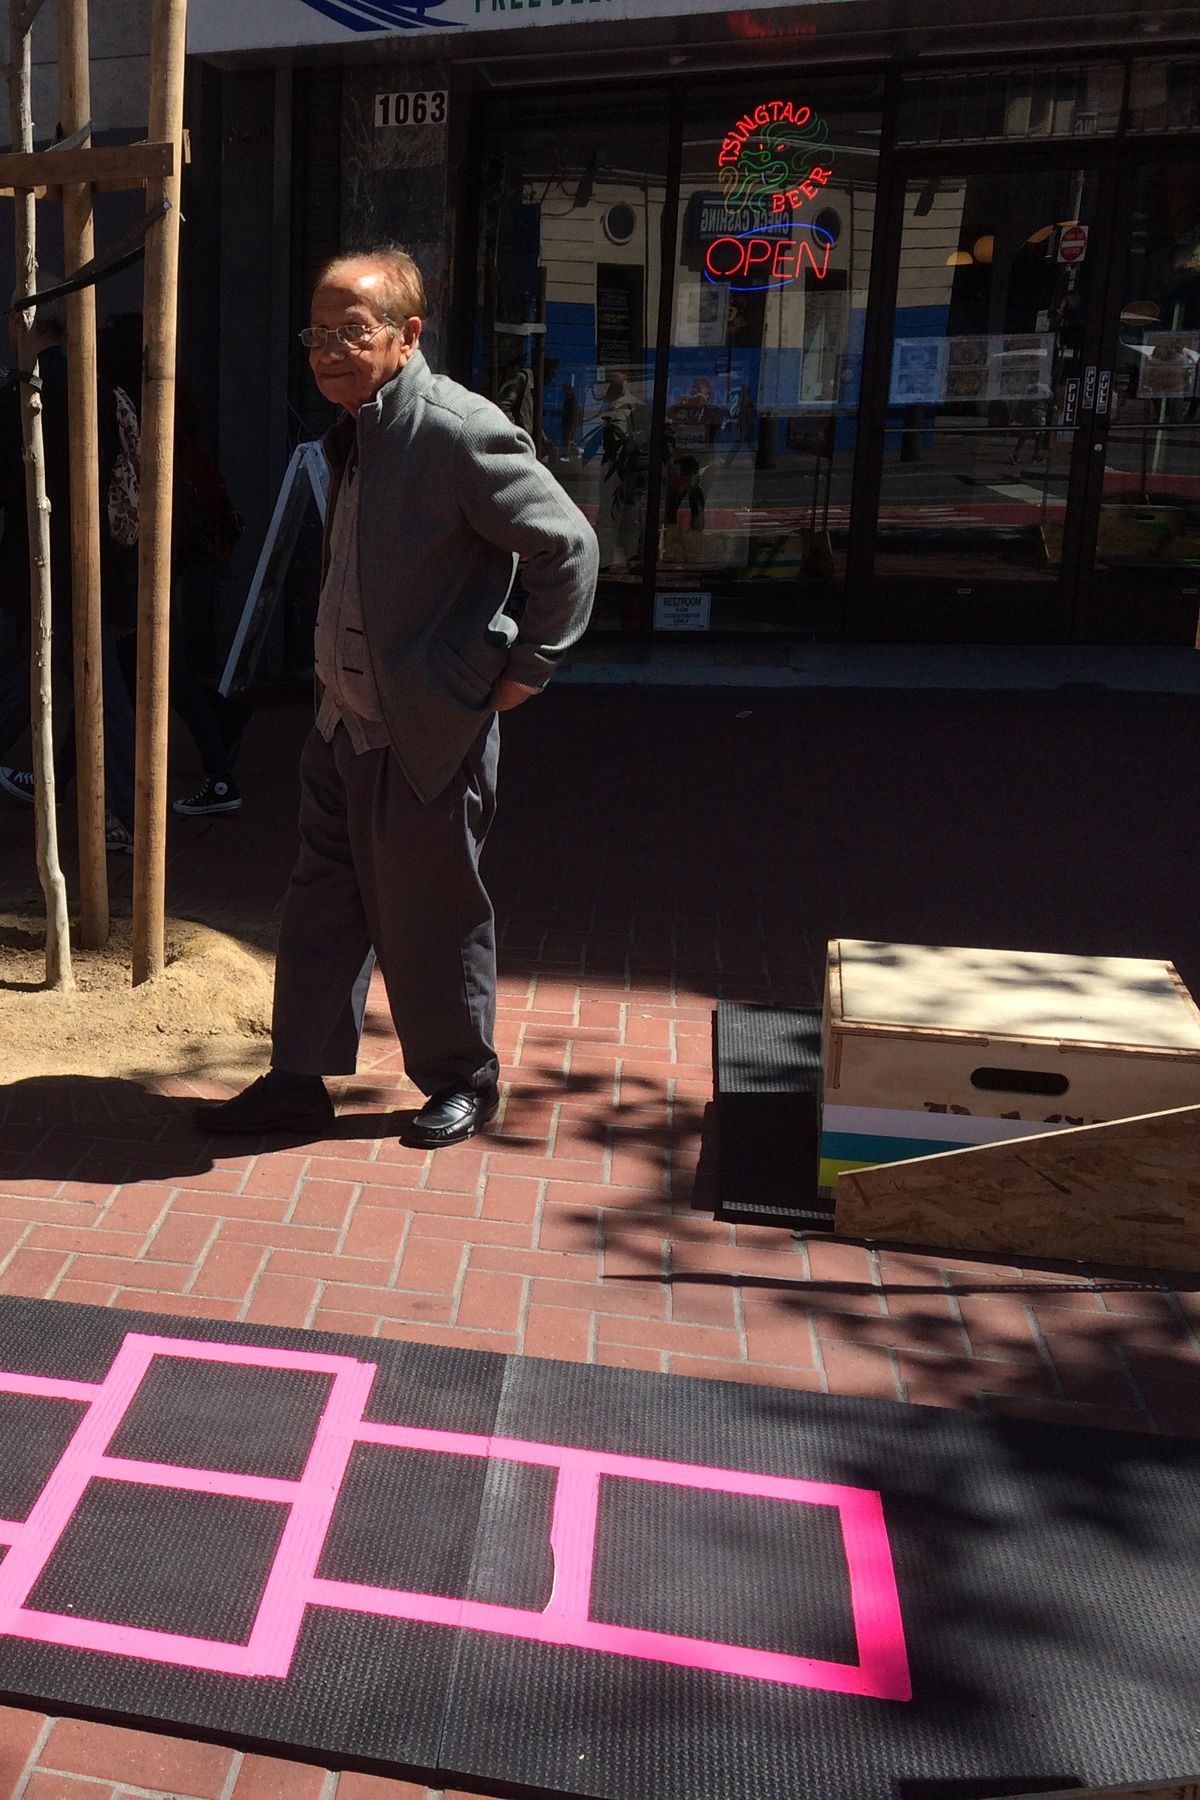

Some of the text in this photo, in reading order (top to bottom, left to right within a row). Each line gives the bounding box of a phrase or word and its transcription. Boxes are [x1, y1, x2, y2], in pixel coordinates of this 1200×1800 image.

[378, 92, 446, 125] 1063
[718, 101, 811, 168] TSINGTAO
[772, 165, 833, 214] BEER
[705, 237, 831, 280] OPEN
[1065, 383, 1077, 423] PULL
